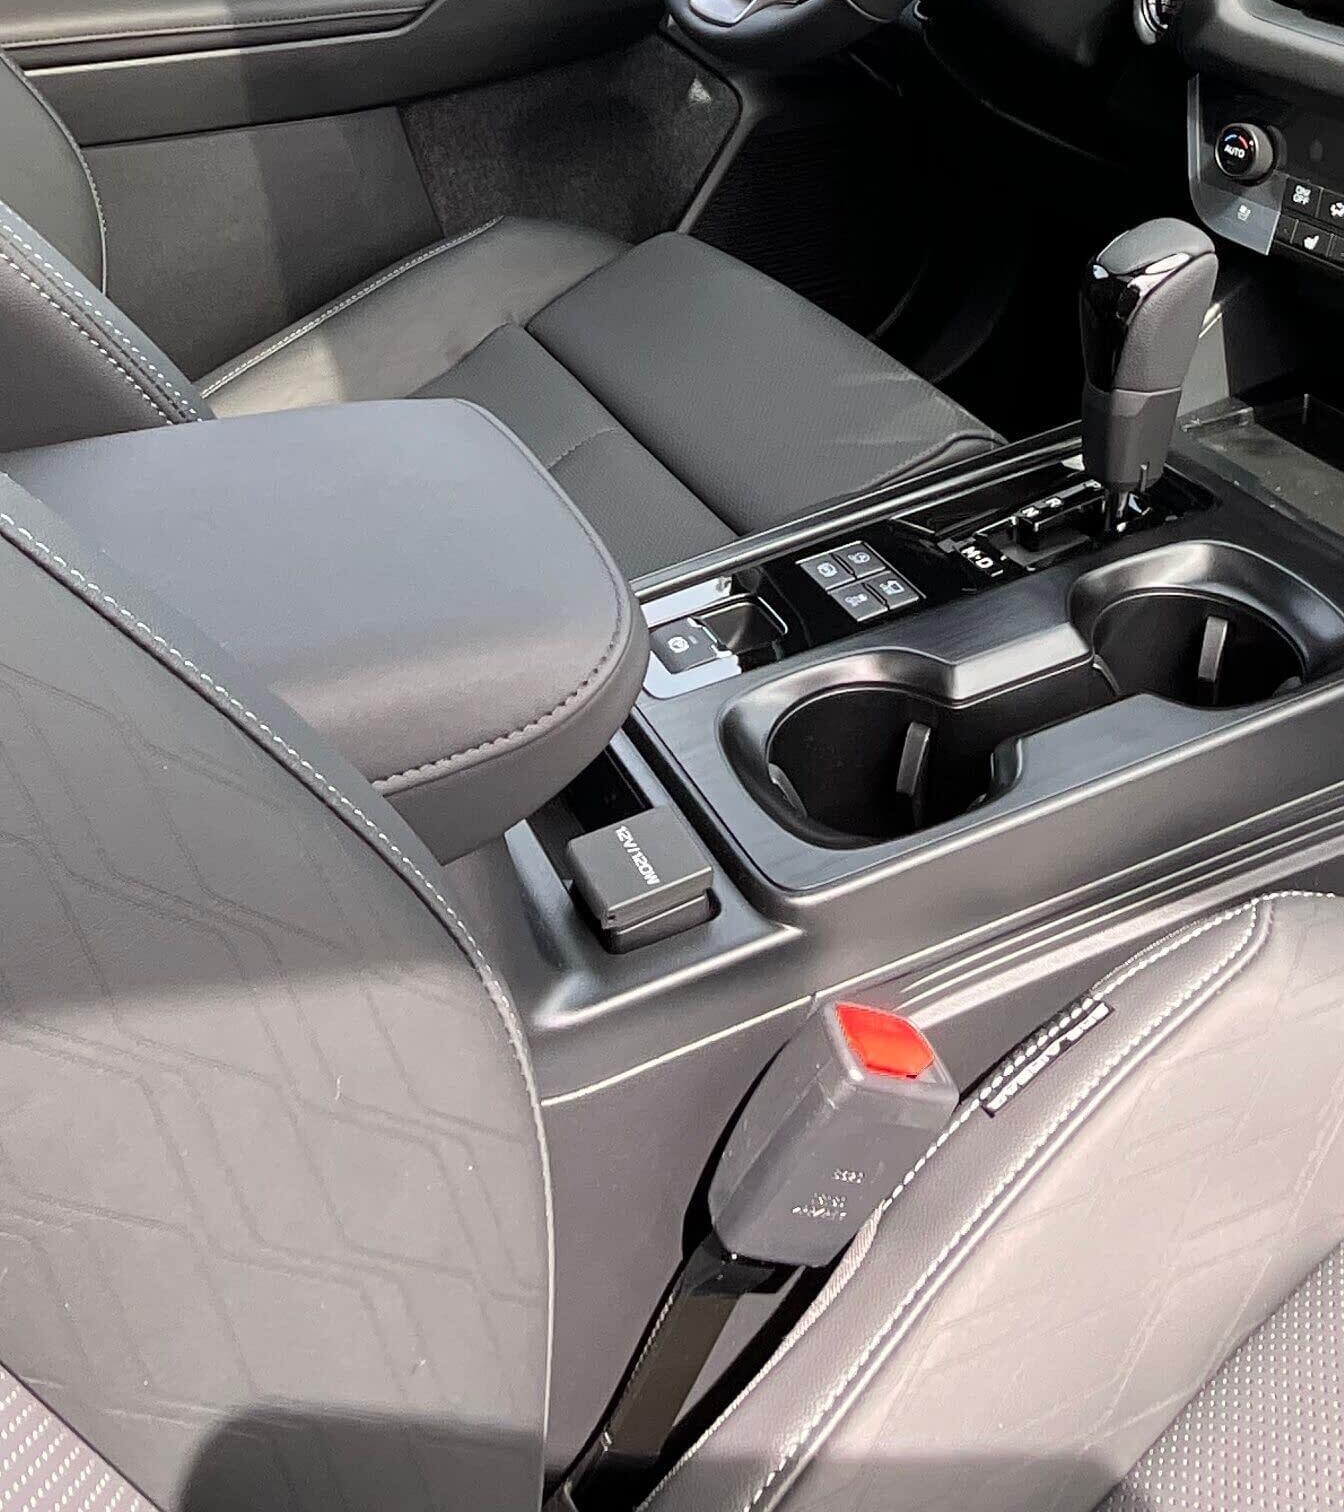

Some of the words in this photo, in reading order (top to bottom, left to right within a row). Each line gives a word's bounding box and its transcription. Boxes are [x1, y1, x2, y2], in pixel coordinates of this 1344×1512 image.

[1223, 143, 1246, 160] AUTO
[1021, 506, 1041, 518] N
[614, 824, 662, 886] 12V/120W
